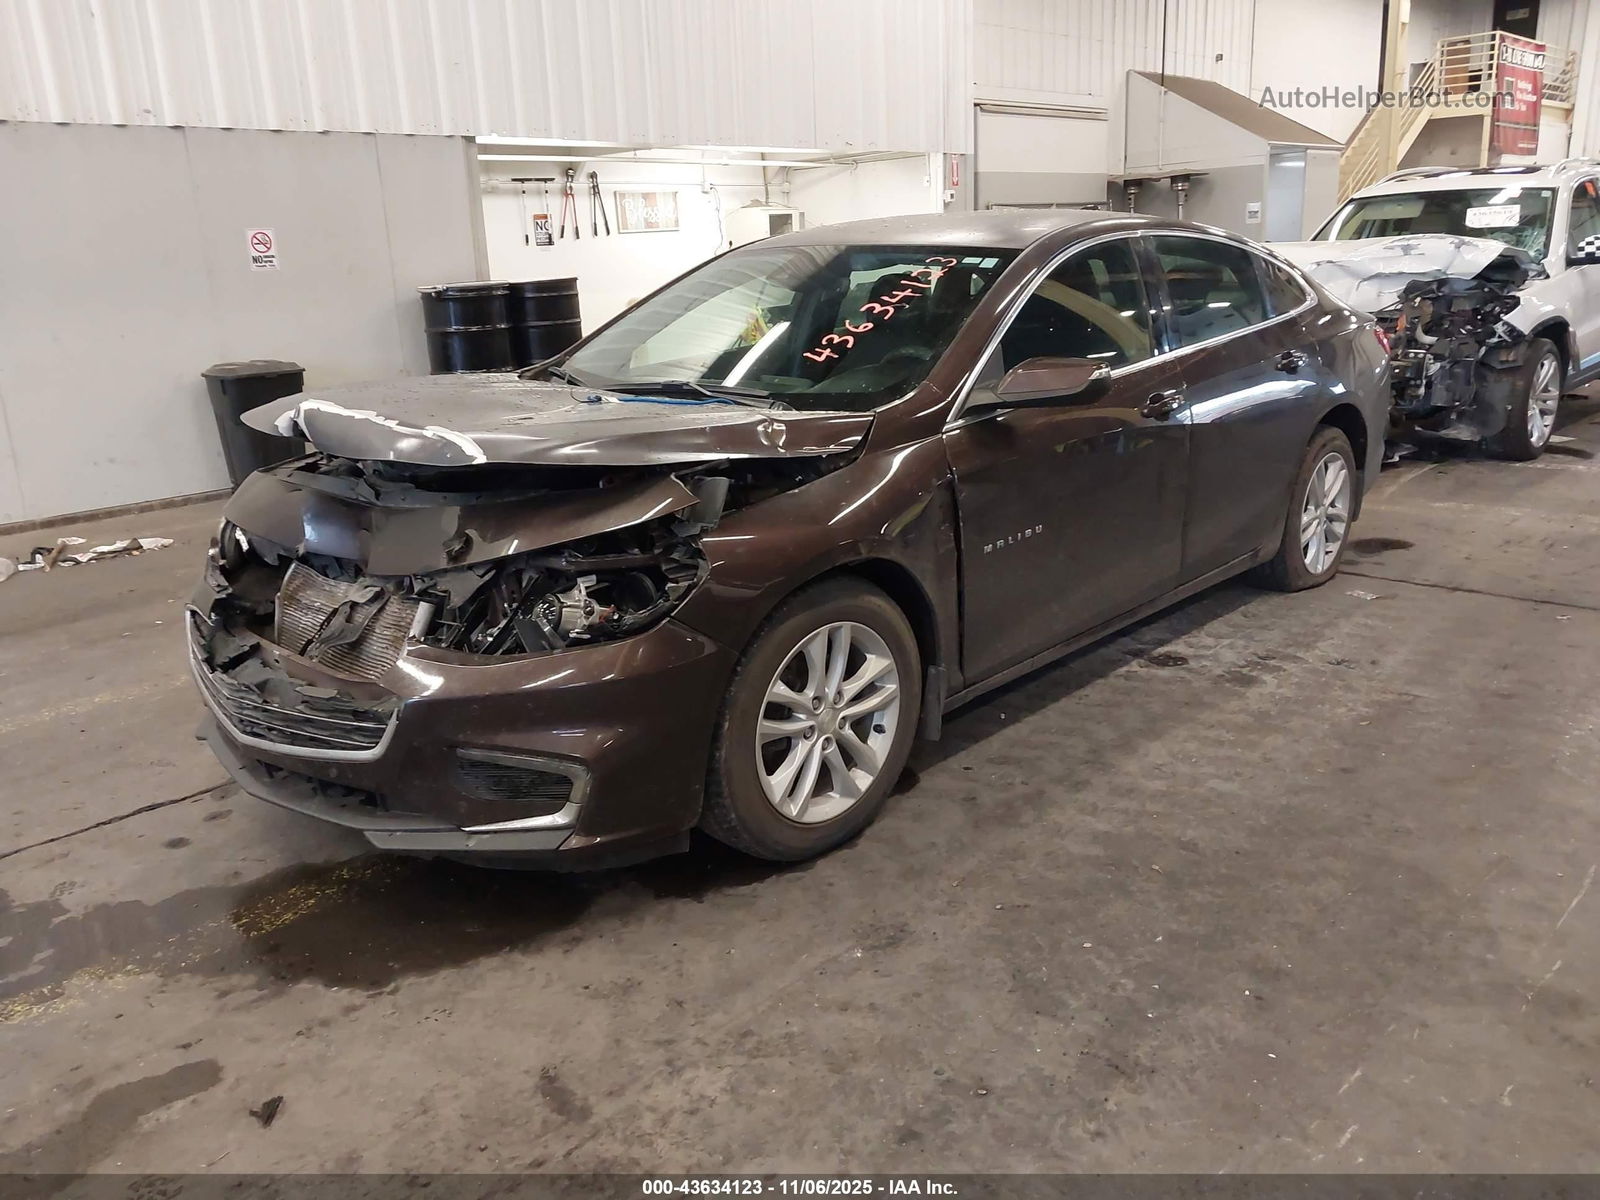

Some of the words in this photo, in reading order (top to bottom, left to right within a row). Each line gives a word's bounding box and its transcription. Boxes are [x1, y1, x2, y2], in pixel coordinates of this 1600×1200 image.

[252, 255, 263, 264] NO
[802, 256, 958, 362] 43634123
[983, 524, 1043, 554] MALIBU
